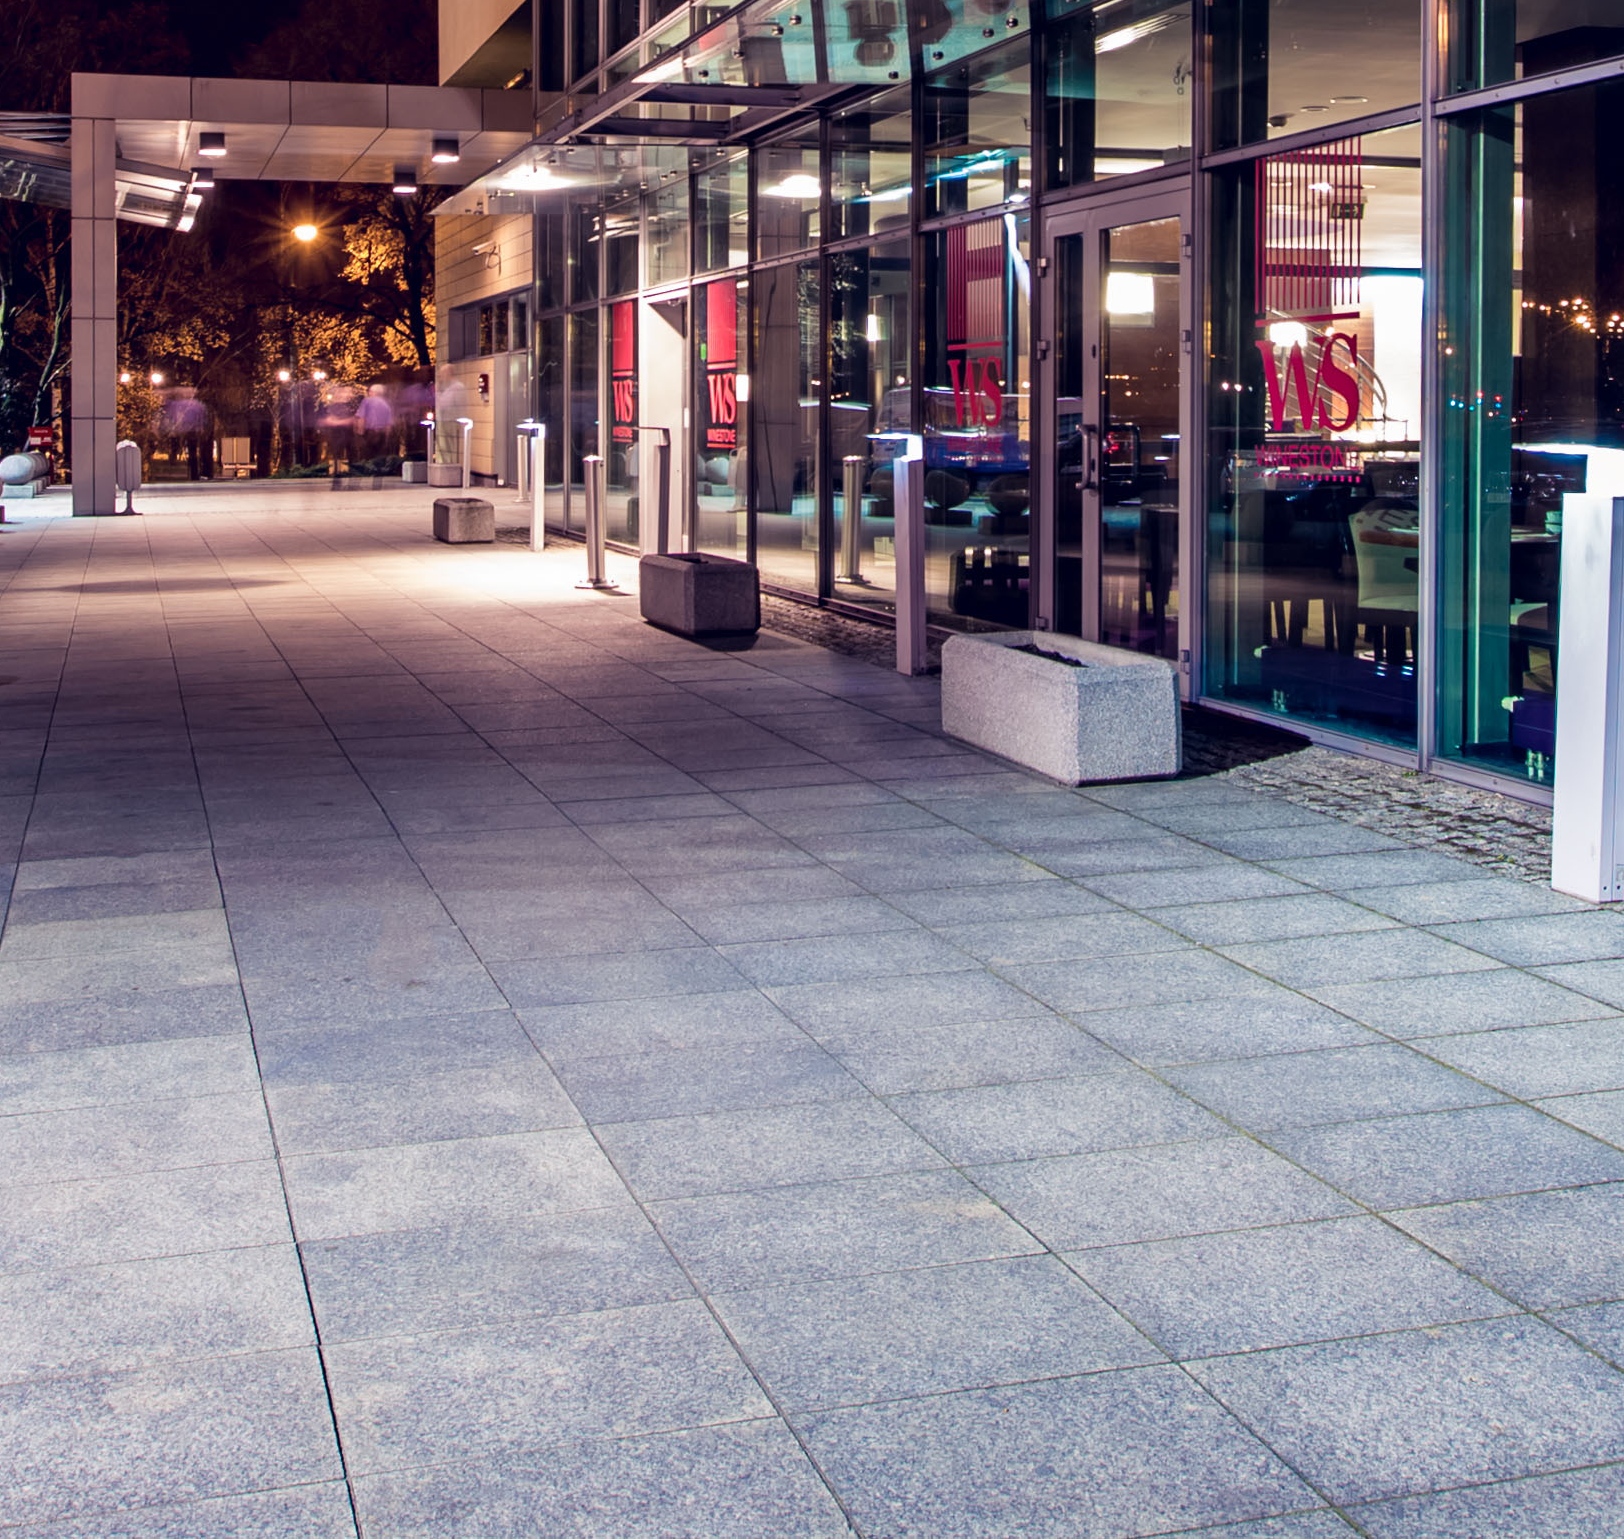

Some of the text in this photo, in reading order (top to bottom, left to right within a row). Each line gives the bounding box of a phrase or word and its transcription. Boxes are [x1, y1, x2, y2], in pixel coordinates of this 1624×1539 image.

[612, 379, 634, 423] WS
[707, 372, 737, 425] WS
[947, 356, 1002, 427] WS
[1255, 333, 1360, 432] WS
[1255, 444, 1361, 471] WINESTONE
